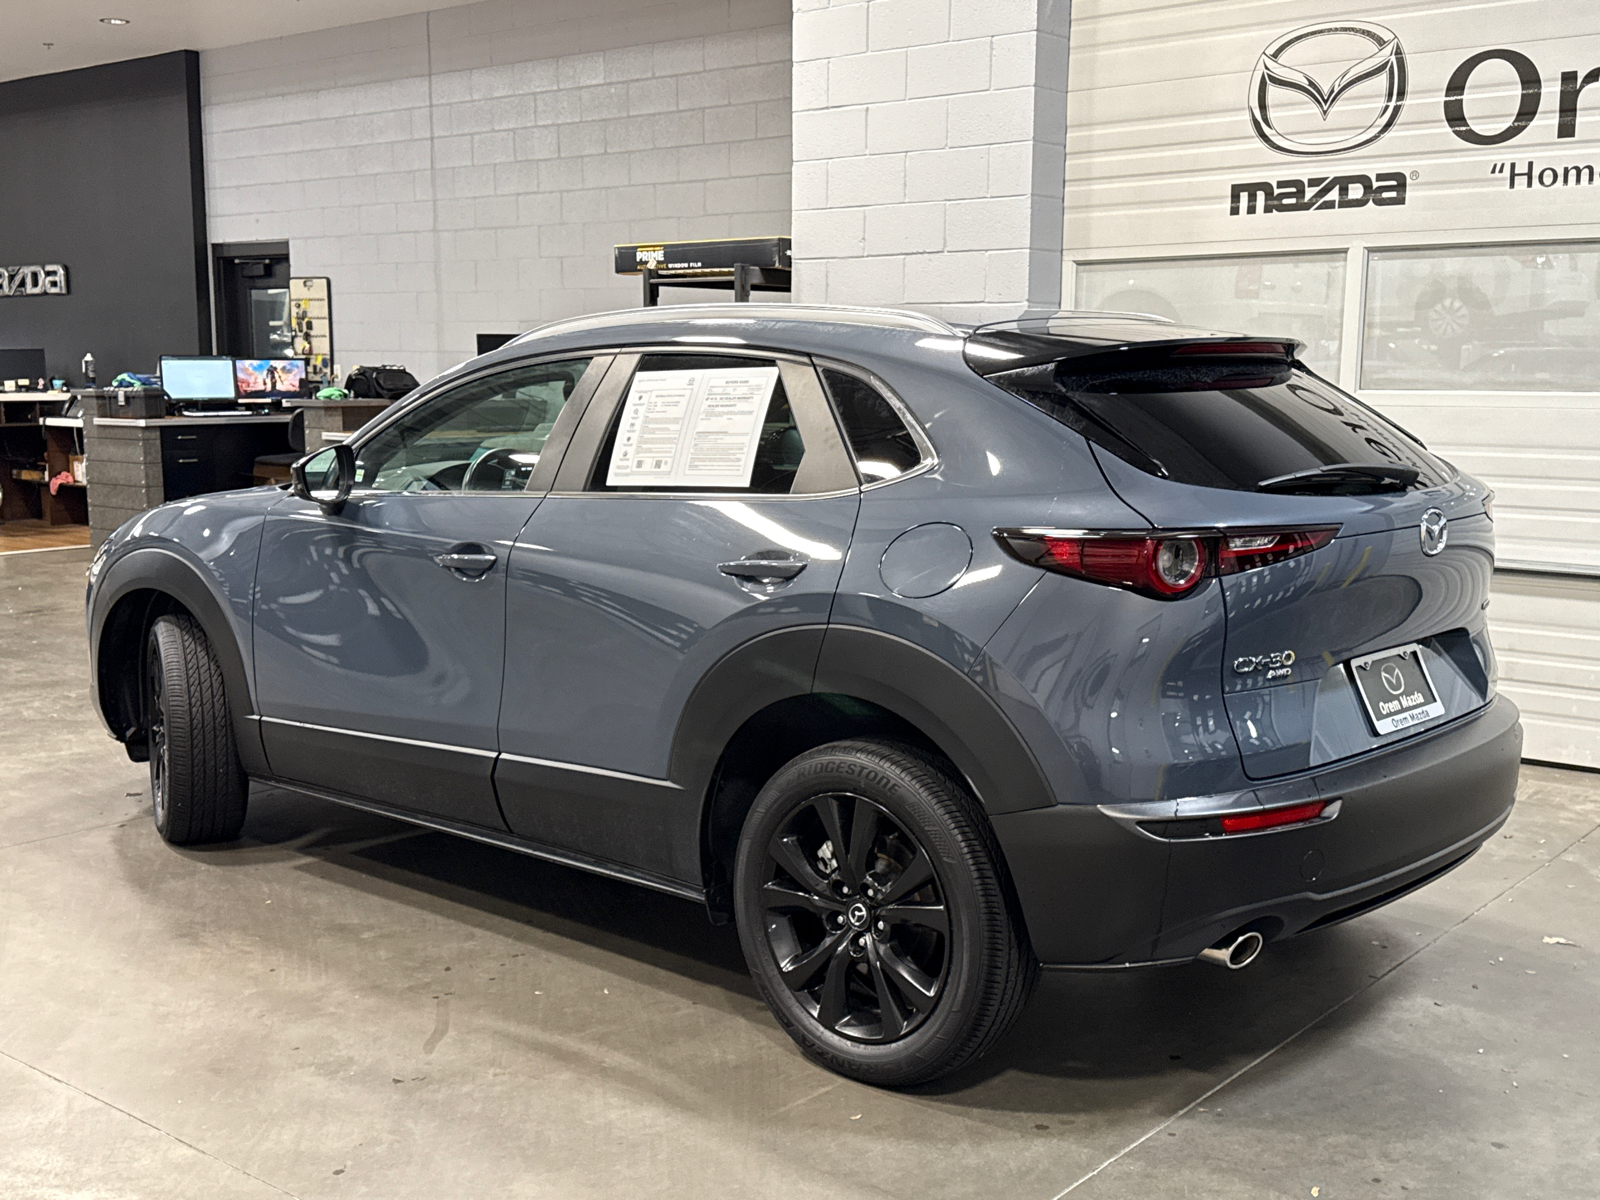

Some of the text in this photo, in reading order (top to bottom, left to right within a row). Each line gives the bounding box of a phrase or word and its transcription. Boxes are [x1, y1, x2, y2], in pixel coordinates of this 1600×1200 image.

[1443, 48, 1600, 146] Or
[1490, 160, 1600, 189] “Hom
[1229, 171, 1407, 216] mazda
[636, 250, 665, 262] PRIME
[1233, 650, 1296, 673] CX-30
[1266, 667, 1291, 679] AWD
[1379, 691, 1425, 715] Orem Mazda
[1391, 709, 1431, 728] Orem Mazda
